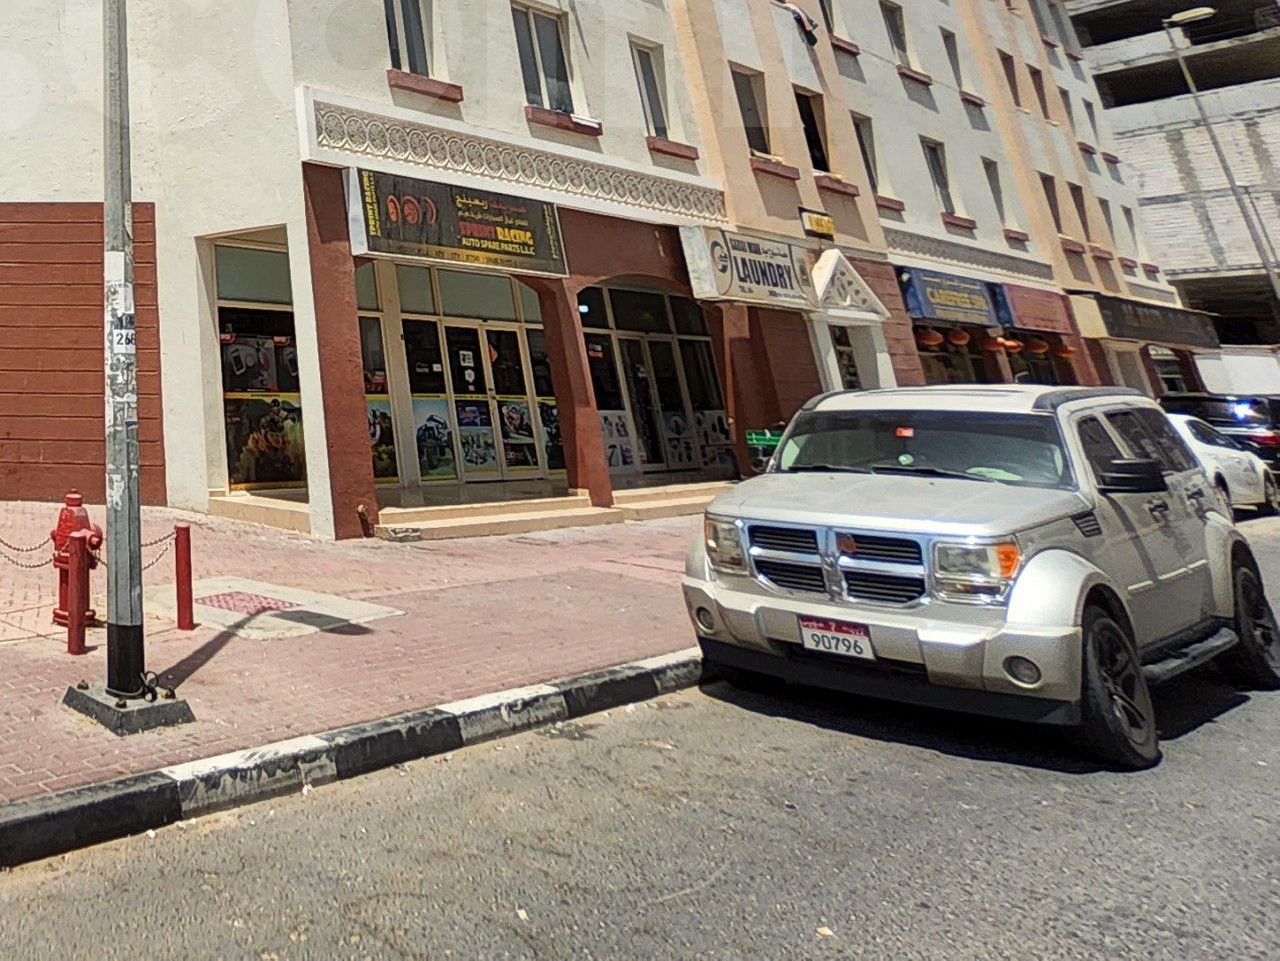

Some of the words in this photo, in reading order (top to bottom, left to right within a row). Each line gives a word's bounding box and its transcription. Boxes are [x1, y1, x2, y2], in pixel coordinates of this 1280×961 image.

[461, 237, 480, 248] AUTO
[480, 239, 500, 251] SPARE
[500, 242, 520, 253] PARTS
[495, 226, 534, 245] RACING
[732, 255, 794, 290] LAUNDRY
[811, 633, 864, 655] 90796
